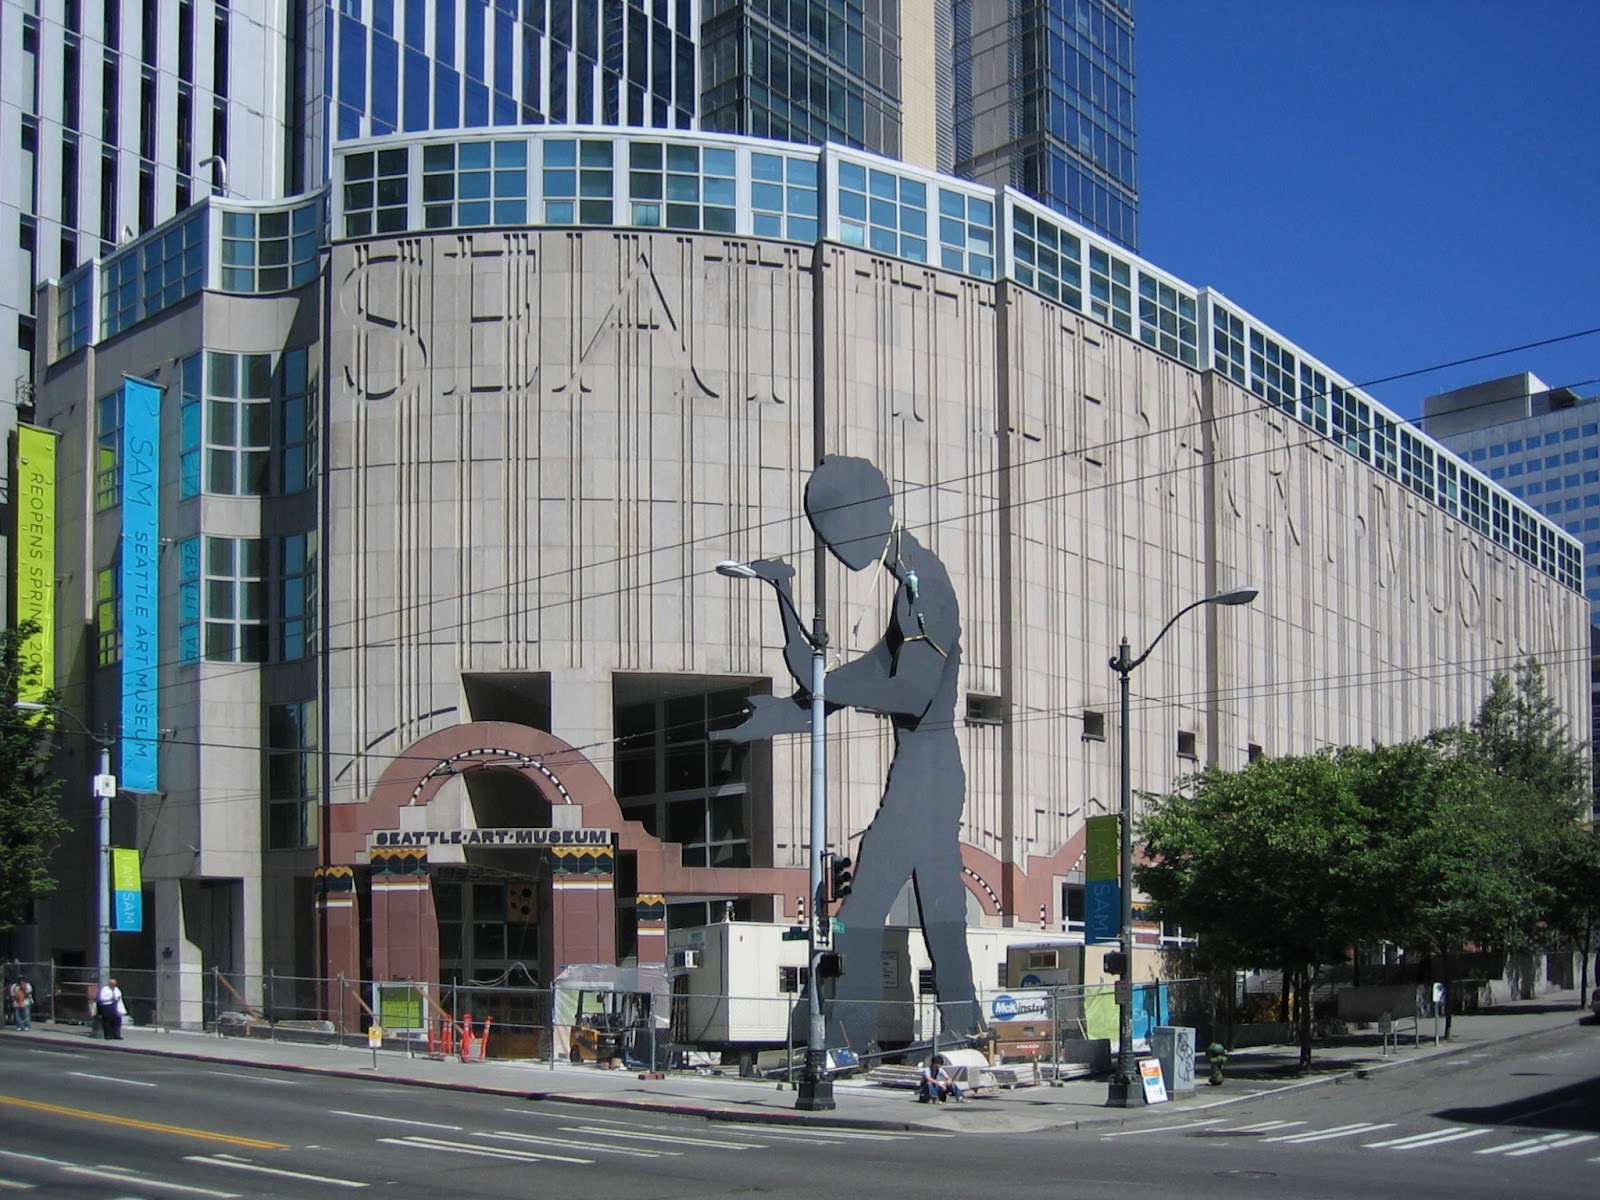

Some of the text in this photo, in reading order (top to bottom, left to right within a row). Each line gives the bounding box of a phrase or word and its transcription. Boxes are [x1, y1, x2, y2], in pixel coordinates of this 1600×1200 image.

[340, 250, 1574, 677] SEATTLE ART MUSEUM
[30, 472, 44, 560] REOPENS
[30, 566, 43, 633] SPRIN
[128, 436, 154, 758] SAM SEATTLE ART MUSEUM
[376, 830, 607, 845] SEATTLE ART MUSEUM
[122, 865, 133, 887] AM
[1096, 842, 1110, 874] AM
[123, 893, 135, 924] SAM
[1093, 883, 1111, 931] SAM
[996, 1002, 1047, 1014] McKinstry
